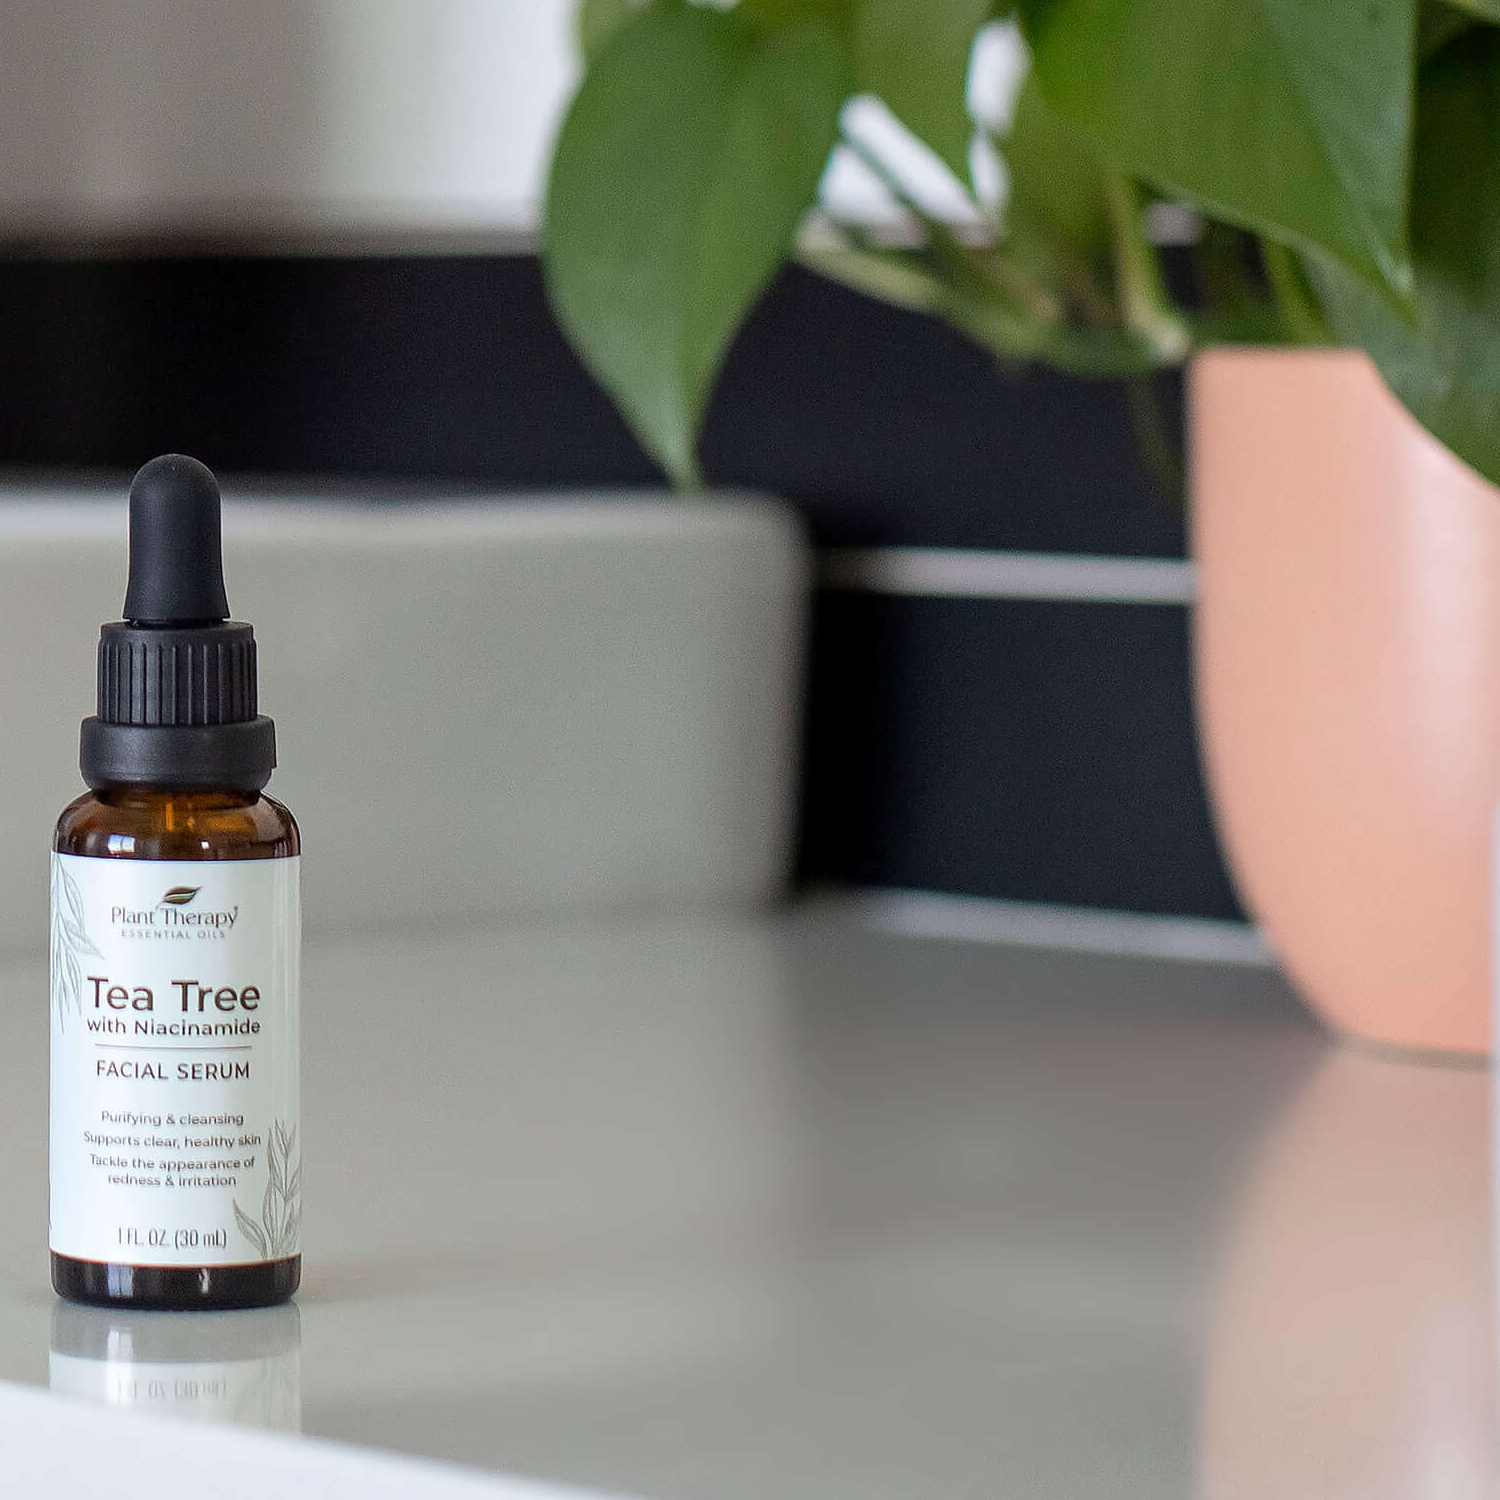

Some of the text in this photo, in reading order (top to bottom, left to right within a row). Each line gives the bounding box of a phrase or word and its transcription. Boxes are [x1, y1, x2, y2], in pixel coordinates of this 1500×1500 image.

[111, 906, 237, 930] Plant Therapy
[121, 930, 226, 940] ESSENTIAL OILS
[87, 975, 261, 1012] Tea Tree
[87, 1016, 261, 1036] with Niacinamide
[96, 1059, 250, 1081] FACIAL SERUM
[101, 1111, 244, 1127] Purifying & cleansing
[83, 1131, 261, 1150] Supports clear, healthy skin
[90, 1153, 256, 1173] Tackle the appearance of
[108, 1172, 237, 1188] redness & irritation
[174, 1228, 199, 1250] (30
